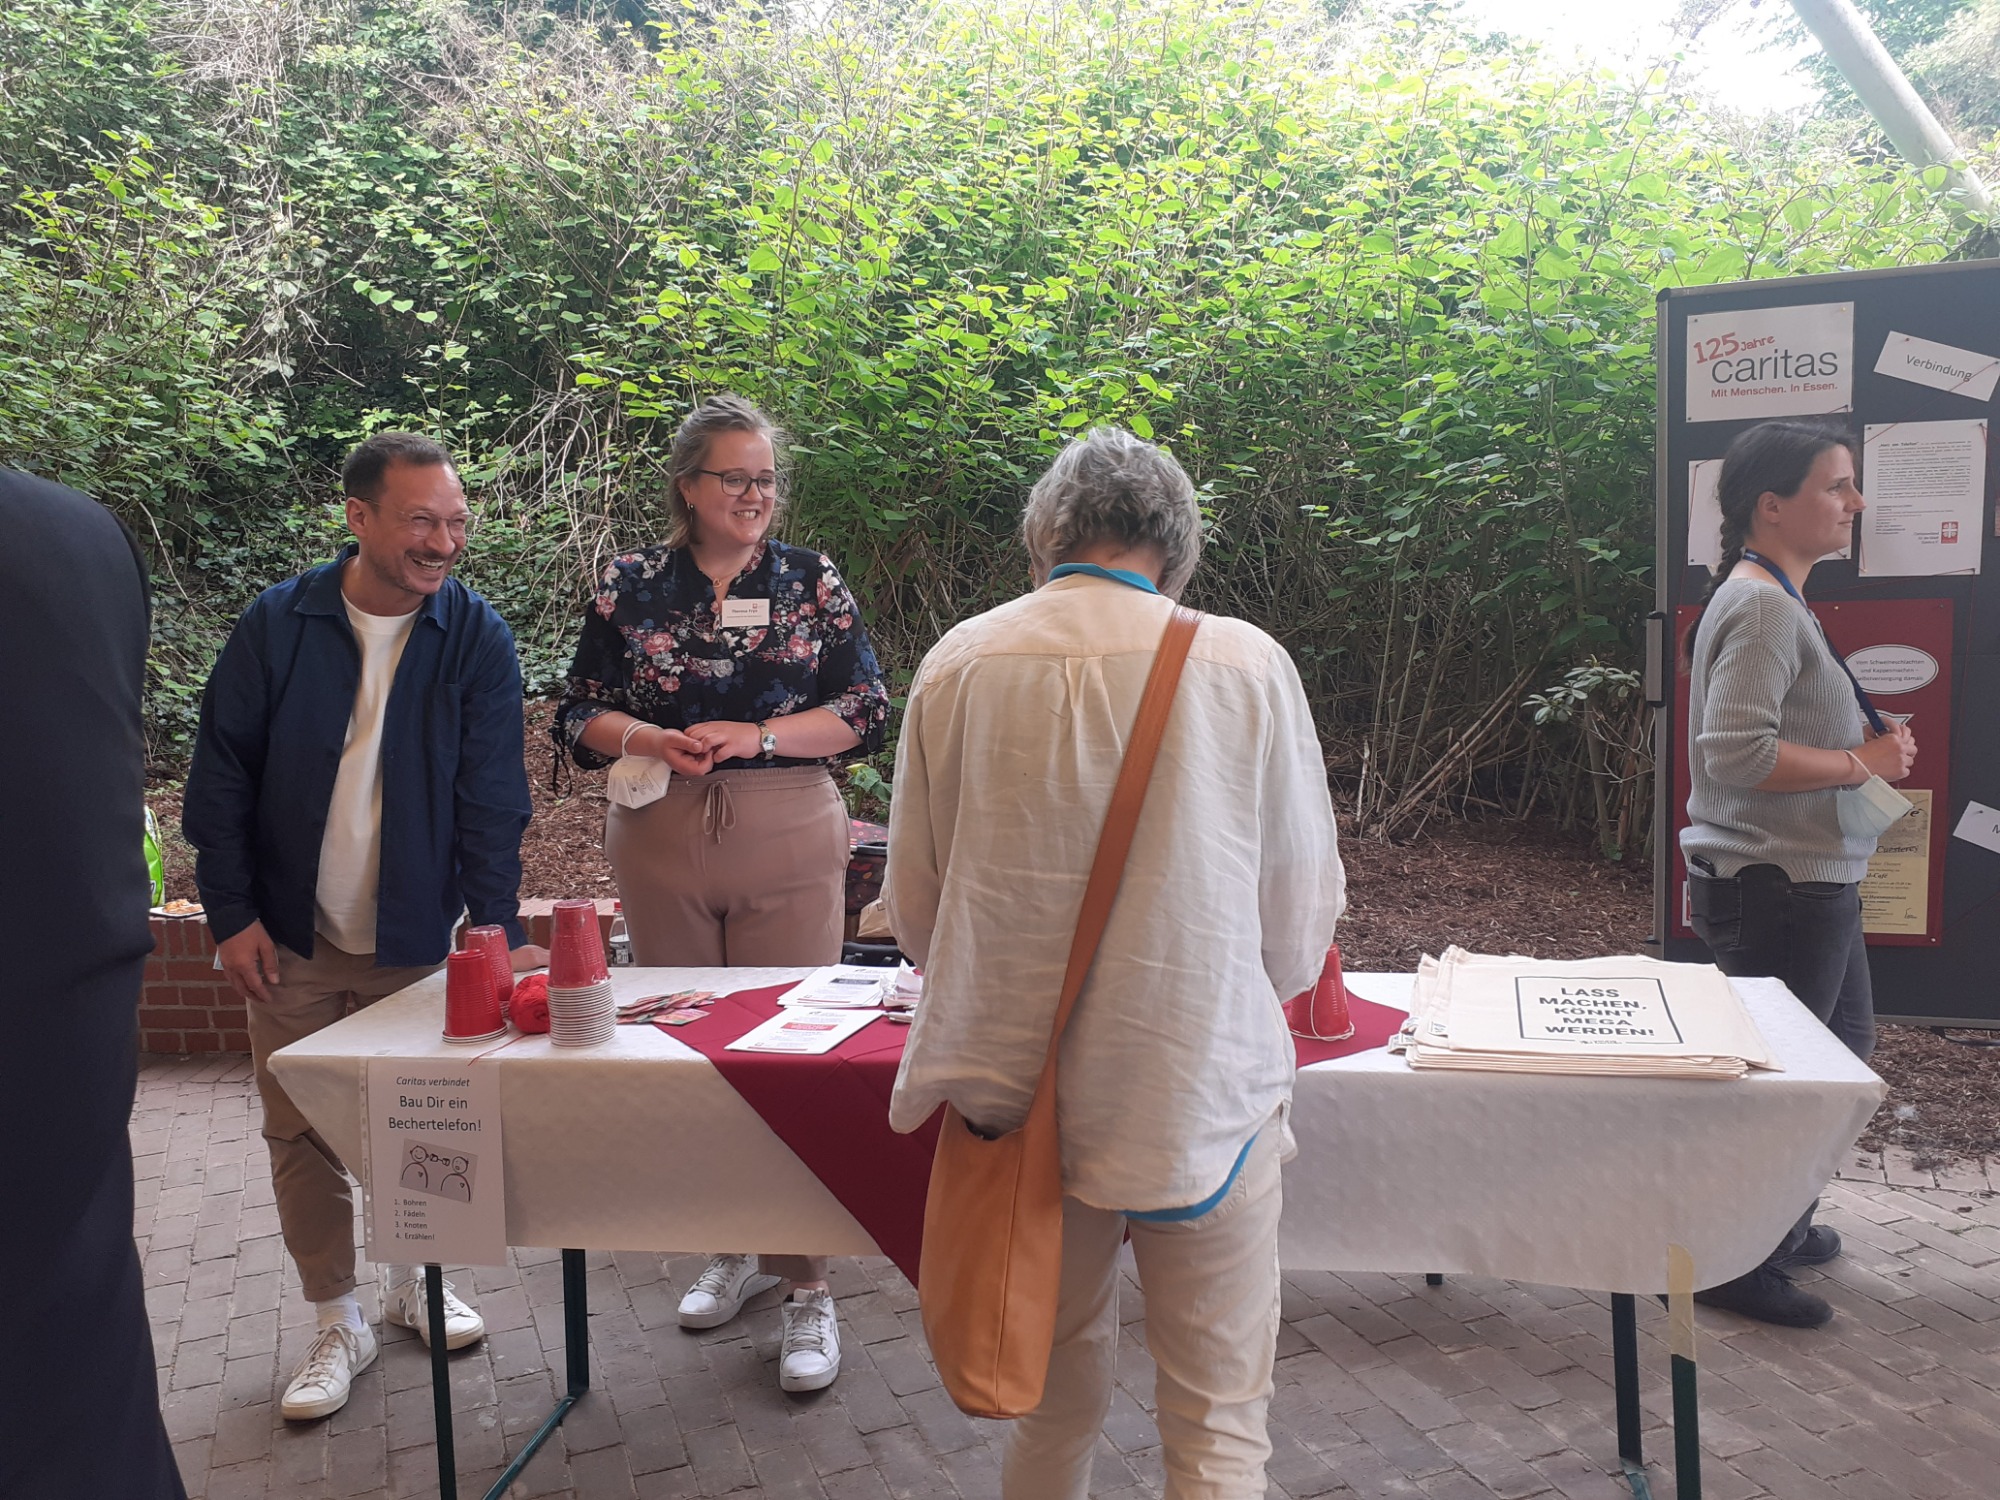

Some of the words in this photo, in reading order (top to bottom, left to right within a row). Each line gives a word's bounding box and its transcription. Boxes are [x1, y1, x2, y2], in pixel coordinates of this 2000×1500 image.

[1693, 332, 1740, 364] 125
[1740, 335, 1775, 351] Jahre
[1711, 348, 1838, 384] caritas
[1906, 354, 1973, 383] Verbindung
[1711, 388, 1728, 398] Mit
[1730, 385, 1786, 397] Menschen.
[1790, 383, 1800, 393] In
[1803, 382, 1838, 392] Essen.
[1561, 987, 1620, 998] LASS
[1554, 1006, 1636, 1017] KÖNNT
[1562, 1017, 1633, 1026] MEGA
[1545, 1026, 1655, 1036] WERDEN!
[396, 1076, 426, 1086] Caritas
[428, 1077, 470, 1087] verbindet
[399, 1095, 423, 1108] Bau
[426, 1096, 445, 1108] Dir
[448, 1096, 468, 1109] ein
[388, 1116, 481, 1132] Bechertelefon!
[403, 1209, 426, 1217] Fädeln
[404, 1221, 428, 1229] Knoten
[404, 1232, 435, 1240] Erzählen!
